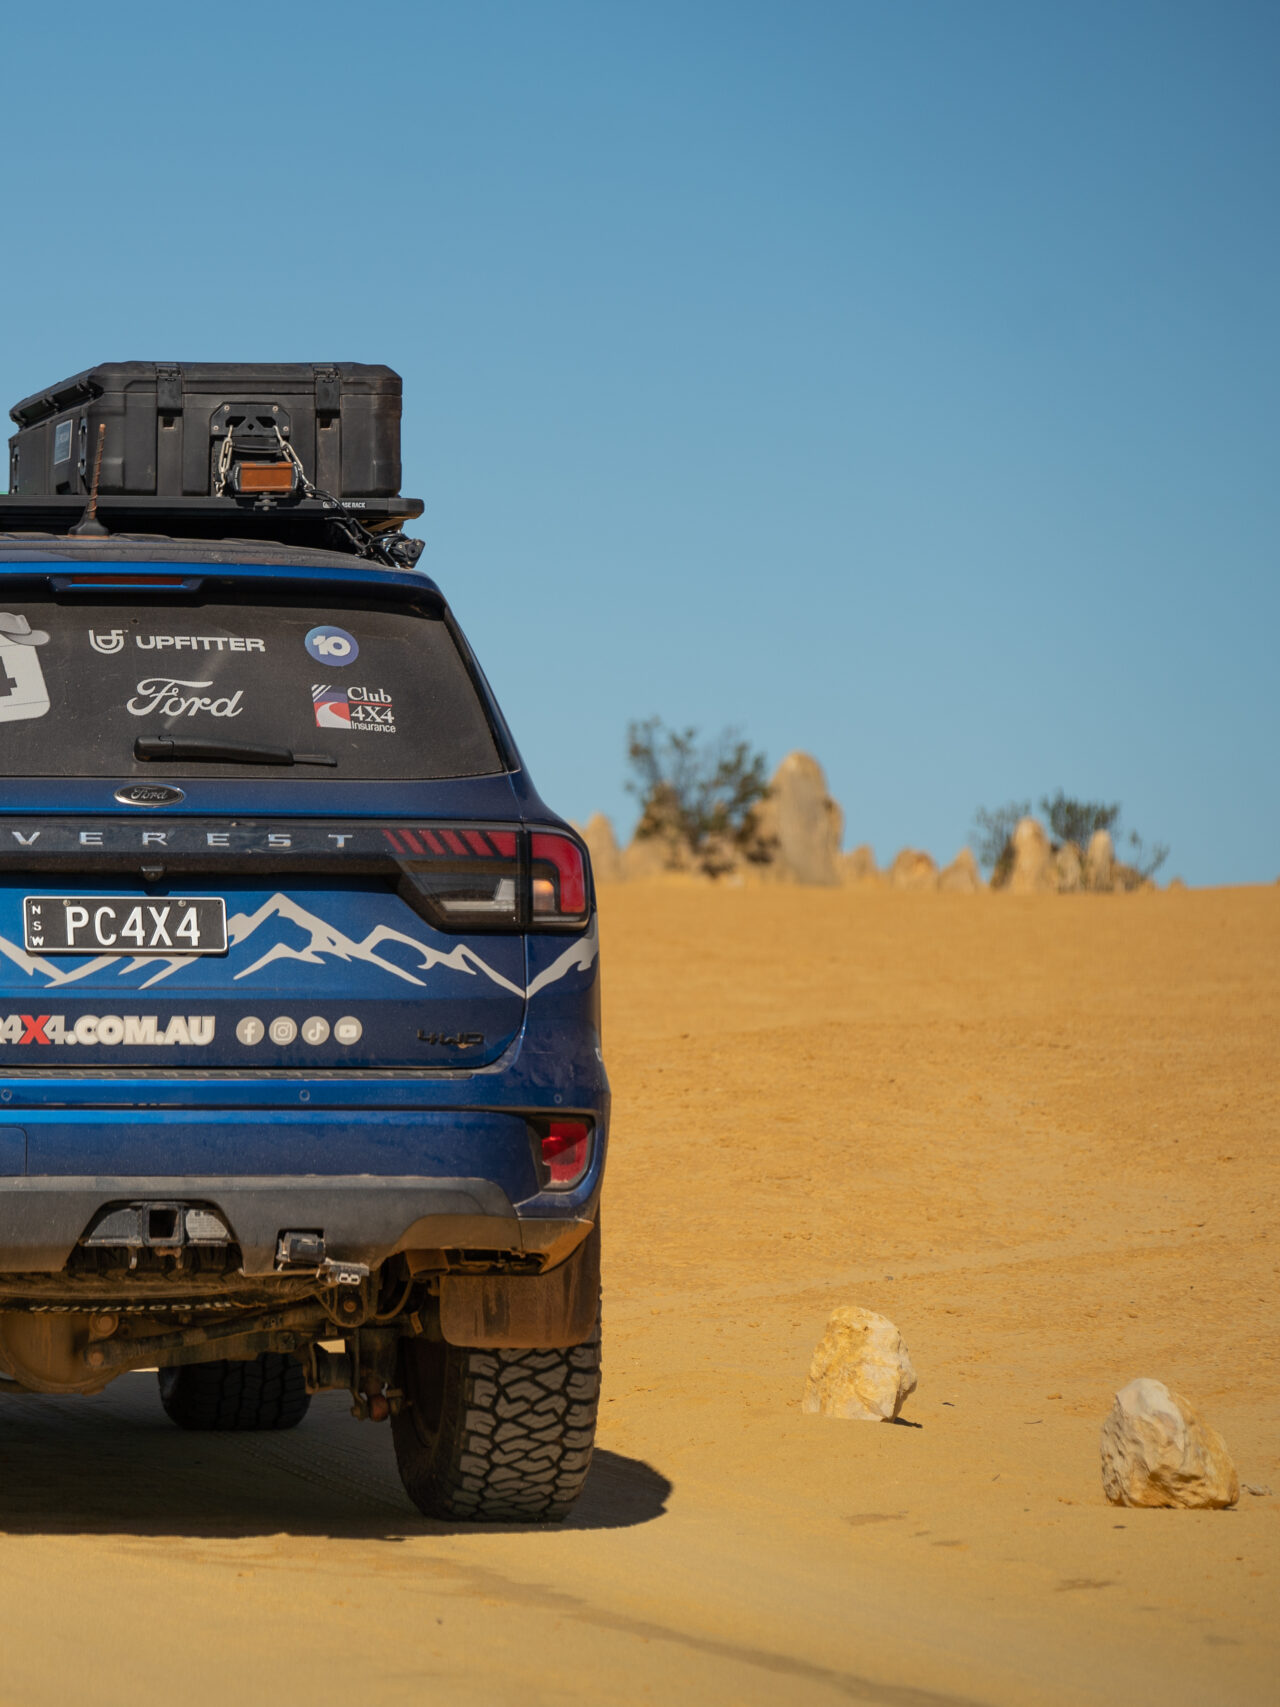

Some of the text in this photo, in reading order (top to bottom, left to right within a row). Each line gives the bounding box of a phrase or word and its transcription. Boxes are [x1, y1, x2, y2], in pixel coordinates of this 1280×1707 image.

[136, 635, 266, 652] UPFITTER
[312, 635, 351, 656] 10
[126, 678, 244, 717] Ford
[347, 686, 392, 703] Club
[350, 705, 395, 723] 4X4
[351, 721, 396, 733] Insurance
[130, 787, 168, 800] Ford
[66, 906, 201, 947] PC4X4
[417, 1028, 484, 1045] 4WD
